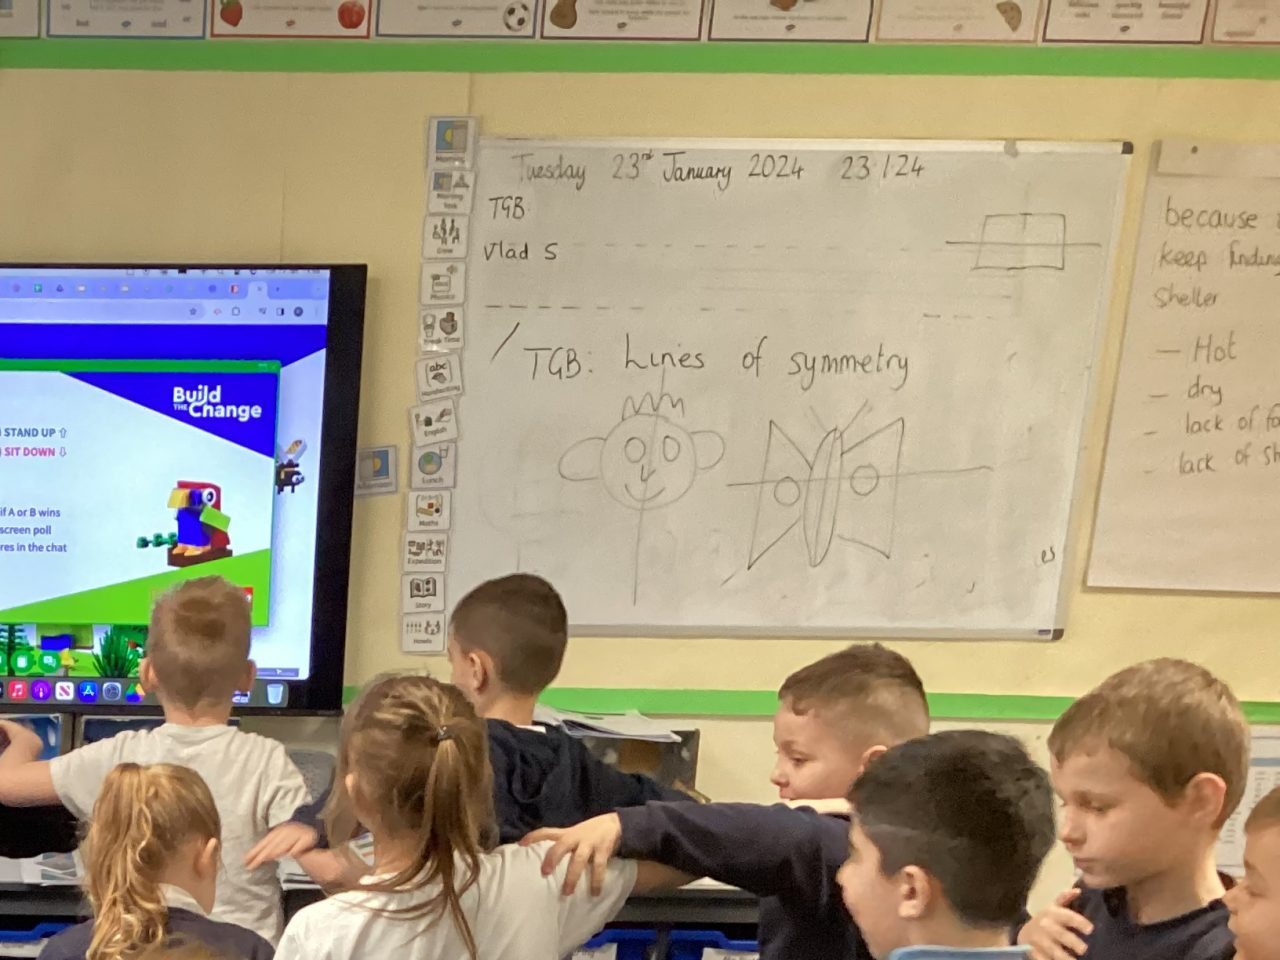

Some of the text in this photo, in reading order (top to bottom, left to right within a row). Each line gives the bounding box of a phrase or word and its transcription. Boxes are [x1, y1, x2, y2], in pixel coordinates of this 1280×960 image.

[512, 152, 586, 190] Tuesday
[663, 151, 732, 191] January
[748, 153, 805, 180] 2024
[489, 196, 525, 219] TGB
[1166, 196, 1258, 229] because
[484, 240, 528, 261] Vlad
[1160, 241, 1207, 272] keep
[1194, 330, 1236, 364] Hot
[429, 361, 447, 372] abc
[624, 333, 705, 370] Lines
[742, 336, 768, 378] of
[788, 344, 909, 391] symmetry
[173, 384, 221, 404] Build
[1188, 374, 1222, 406] dry
[189, 402, 262, 422] Change
[1186, 411, 1223, 434] lack
[1238, 405, 1259, 431] of
[4, 428, 39, 437] STAND
[41, 428, 56, 438] UP
[4, 447, 21, 456] SIT
[23, 447, 55, 457] DOWN
[1179, 451, 1216, 474] lack
[1235, 441, 1252, 466] of
[0, 507, 7, 516] if
[8, 508, 15, 517] A
[17, 509, 27, 517] or
[29, 507, 36, 517] B
[38, 508, 61, 517] wins
[33, 525, 51, 537] poll
[16, 543, 26, 552] in
[28, 542, 44, 552] the
[46, 542, 67, 552] chat
